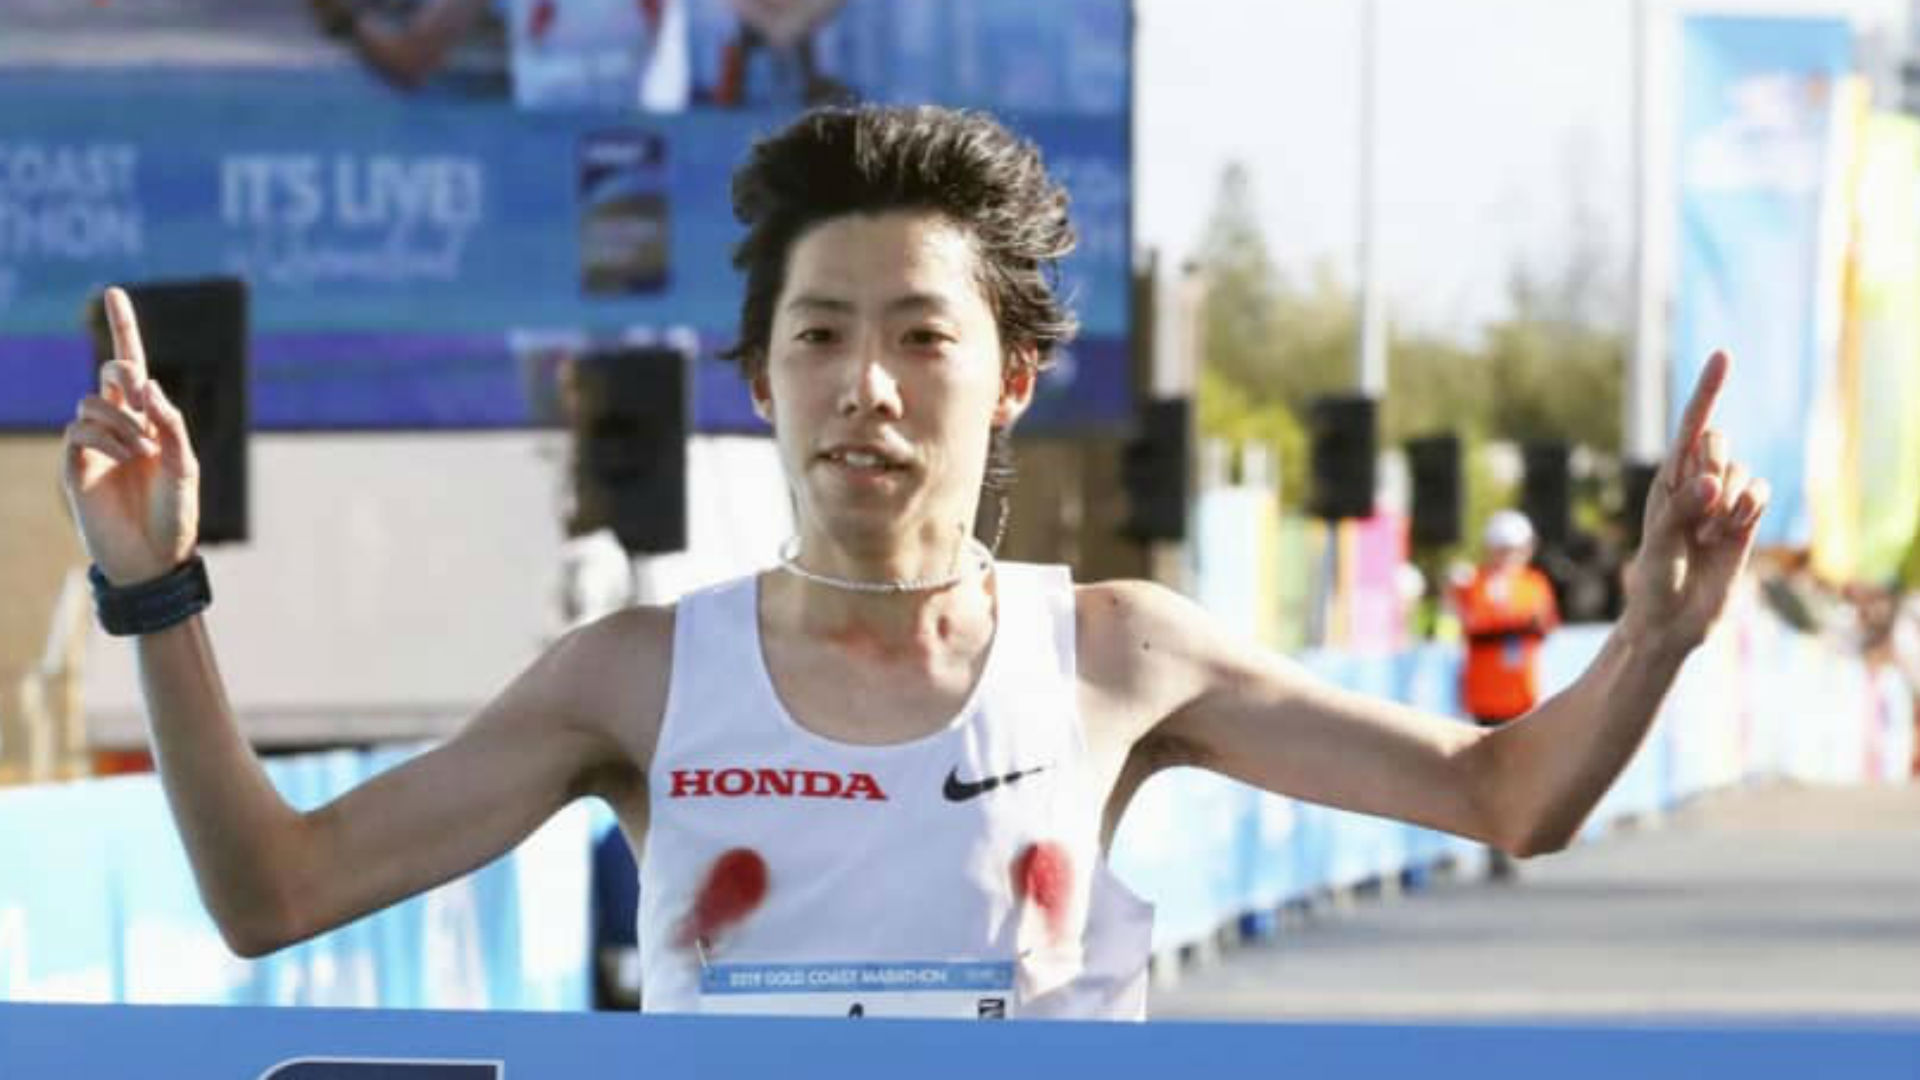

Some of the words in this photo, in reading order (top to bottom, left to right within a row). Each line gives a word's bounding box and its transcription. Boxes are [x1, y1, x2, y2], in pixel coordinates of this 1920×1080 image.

[670, 768, 889, 801] HONDA
[766, 970, 804, 986] GOLD
[808, 969, 858, 985] COAST
[862, 969, 947, 985] MARATHON
